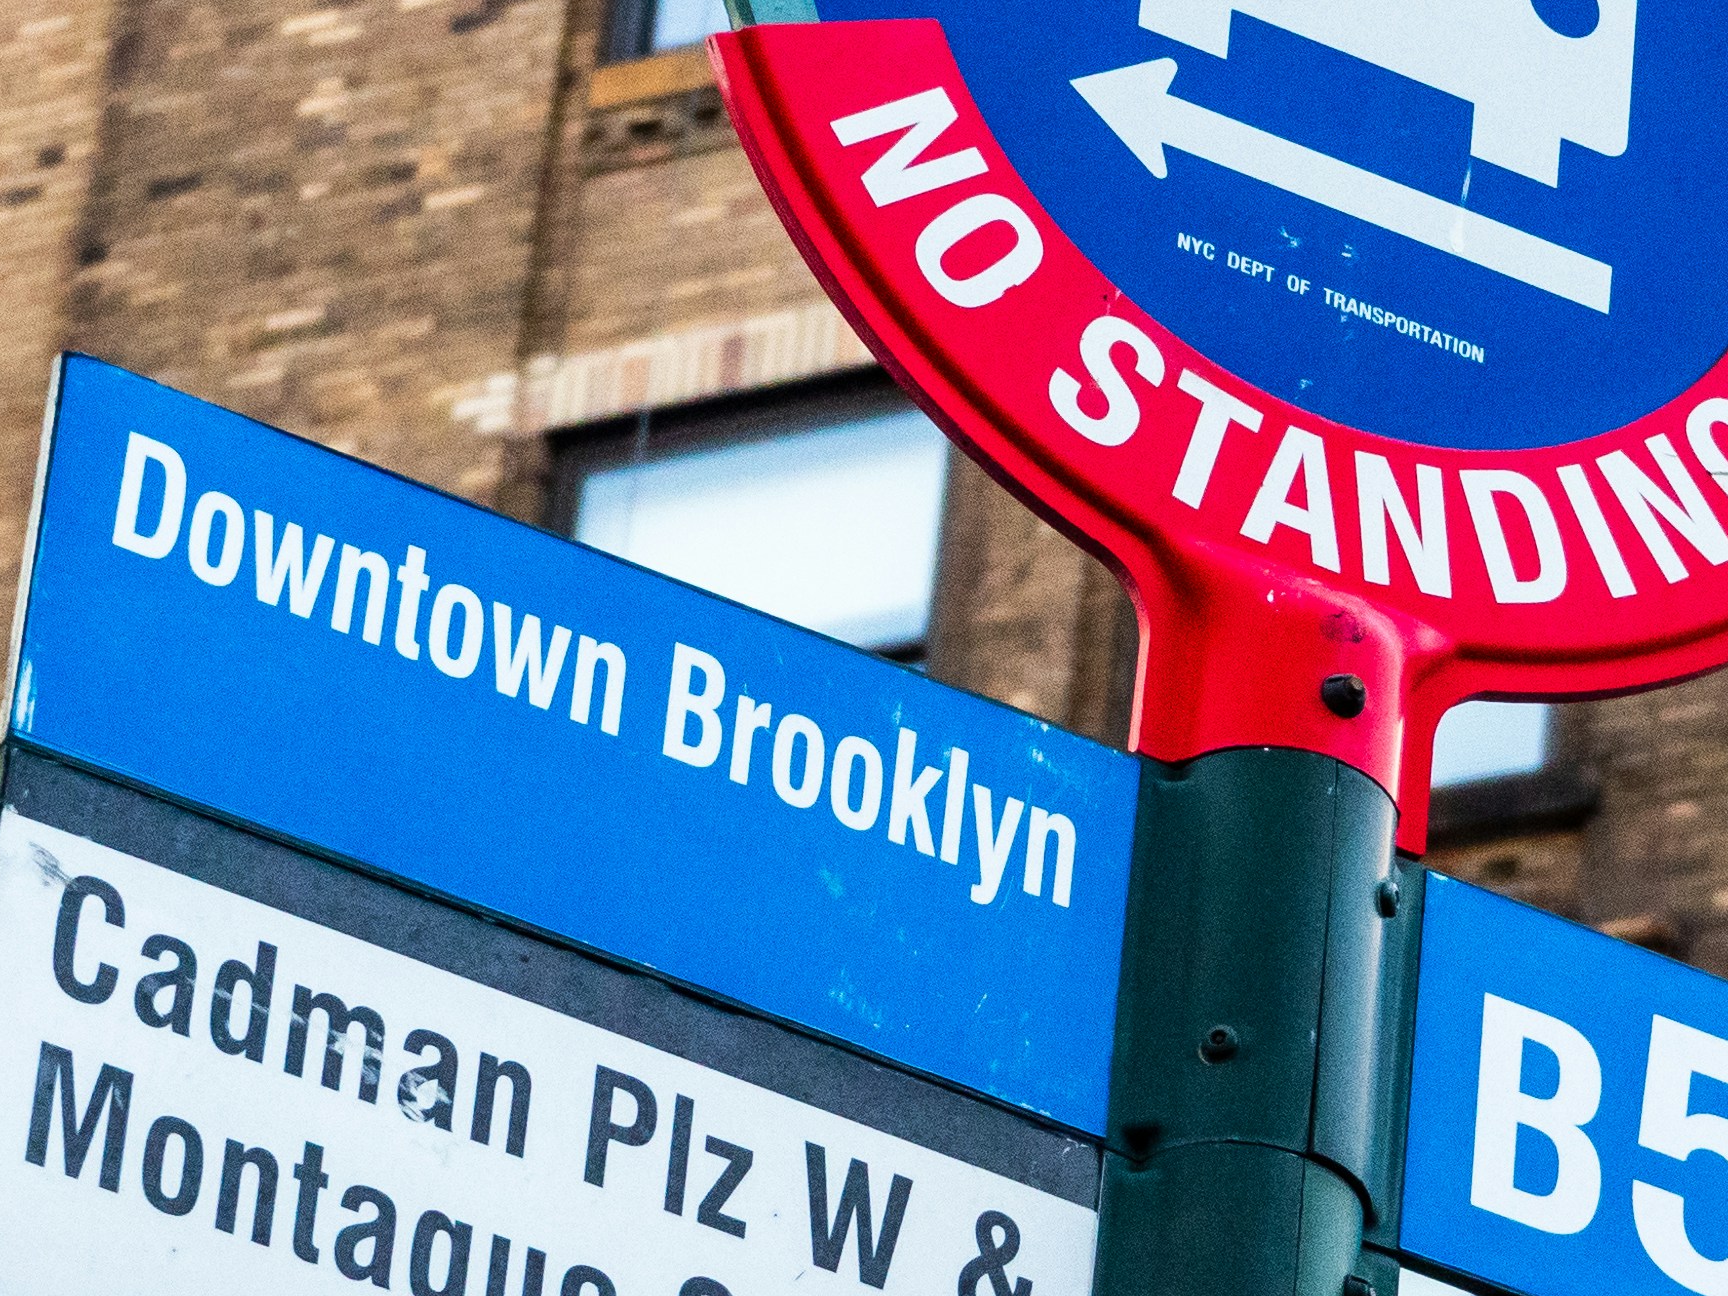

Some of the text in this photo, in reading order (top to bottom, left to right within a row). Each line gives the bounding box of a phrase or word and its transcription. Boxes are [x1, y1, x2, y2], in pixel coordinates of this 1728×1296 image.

[830, 87, 1043, 307] NO
[1177, 232, 1484, 363] NYC DEPT OF TRANSPORTATION
[113, 432, 1076, 907] Downtown Brooklyn
[54, 876, 531, 1158] Cadman
[584, 1065, 753, 1238] Plz
[806, 1141, 913, 1289] W
